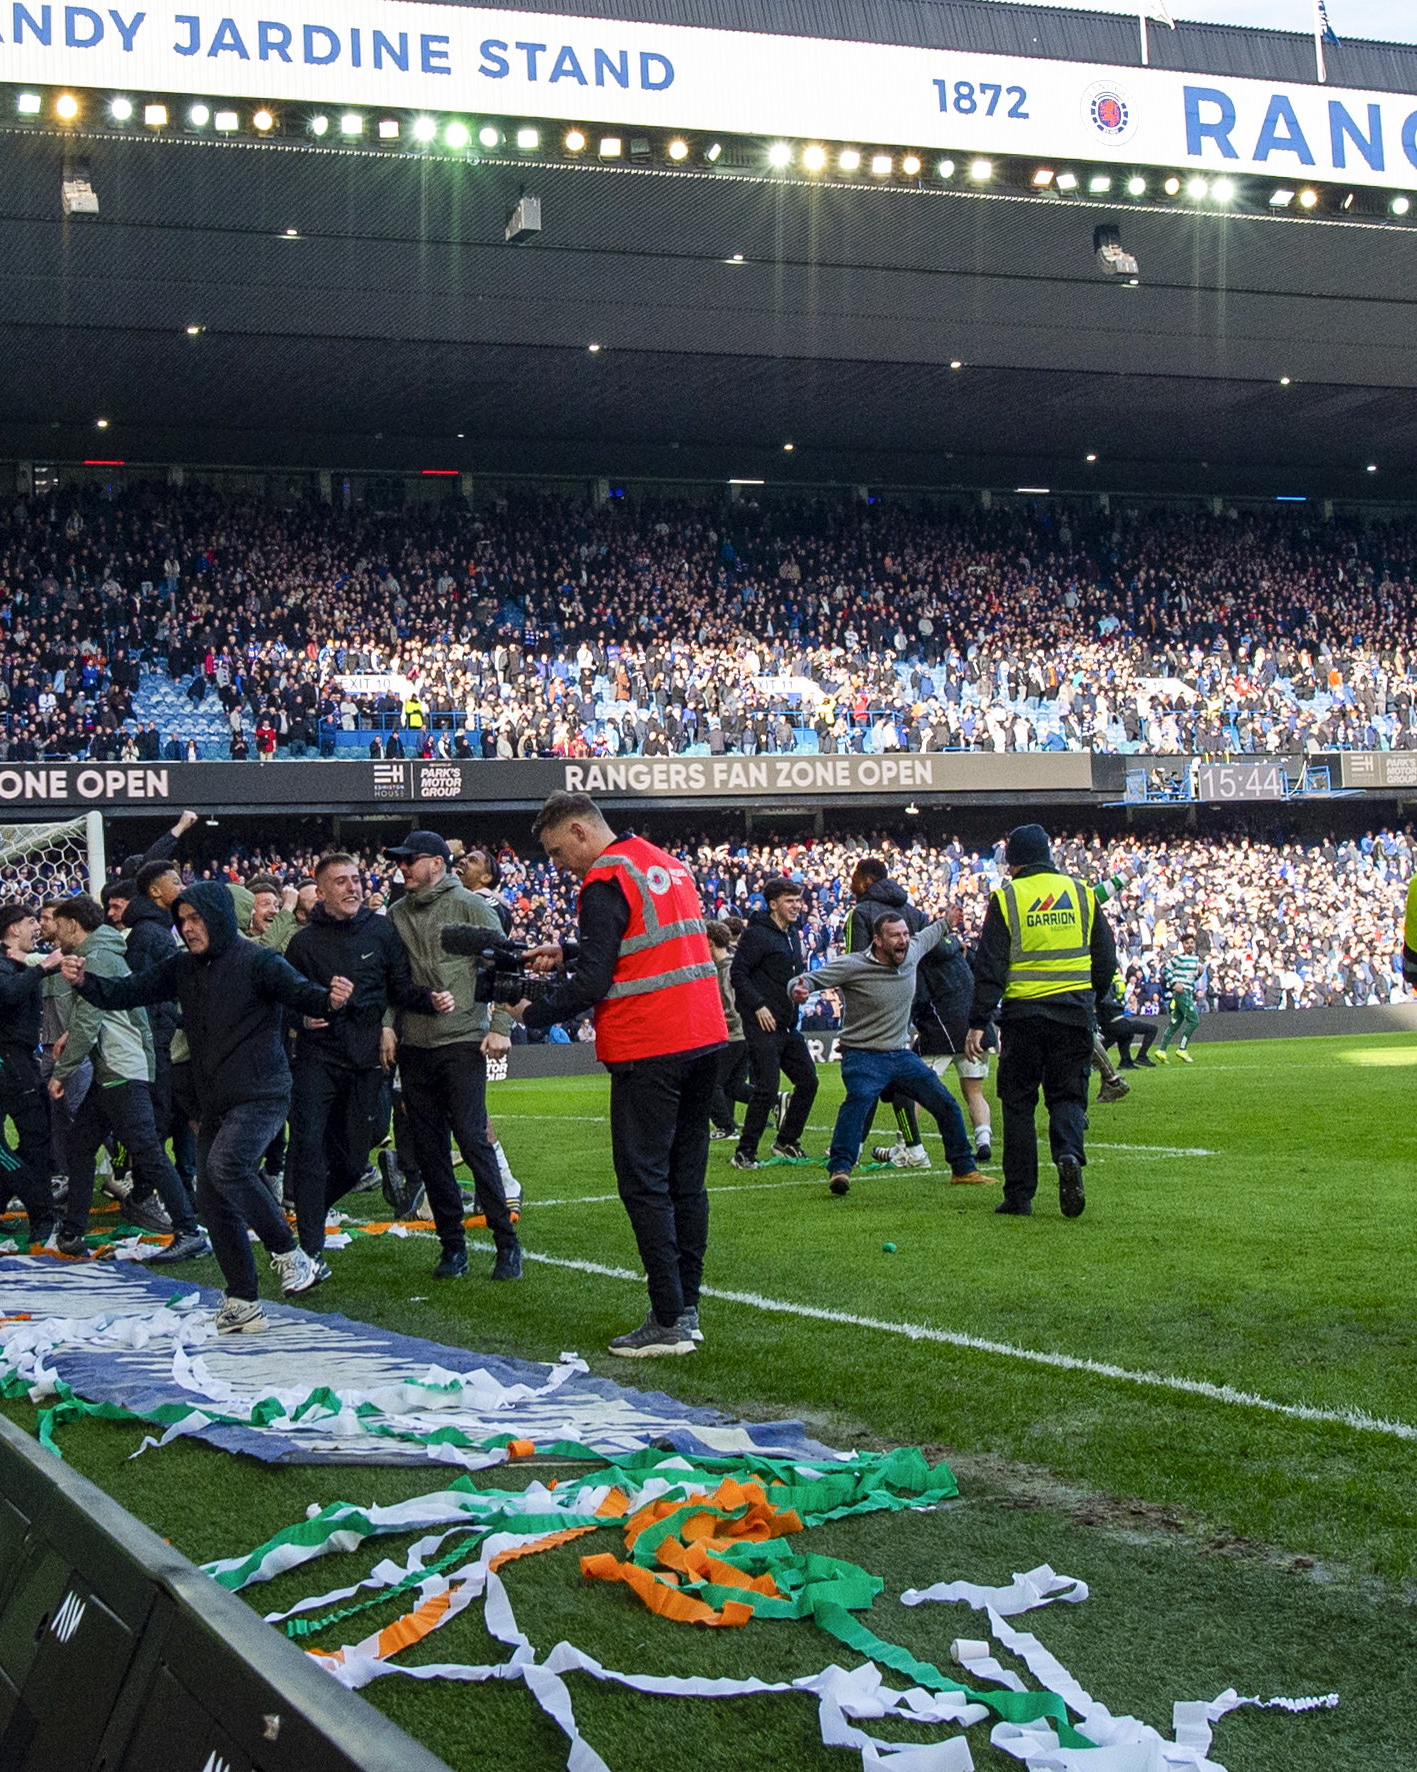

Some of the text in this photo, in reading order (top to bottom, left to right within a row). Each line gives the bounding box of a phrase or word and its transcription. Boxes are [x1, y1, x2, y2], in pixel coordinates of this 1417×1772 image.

[173, 15, 451, 75] JARDINE
[478, 39, 675, 91] STAND
[932, 78, 1029, 119] 1872
[378, 678, 391, 690] 10
[421, 768, 461, 778] PARK'S
[565, 759, 933, 792] RANGERS FAN ZONE OPEN
[1386, 775, 1417, 784] GROUP
[76, 769, 169, 798] OPEN
[421, 777, 462, 787] MOTOR
[1202, 767, 1280, 798] 15:44
[421, 787, 461, 797] GROUP
[1027, 912, 1076, 927] GARRION
